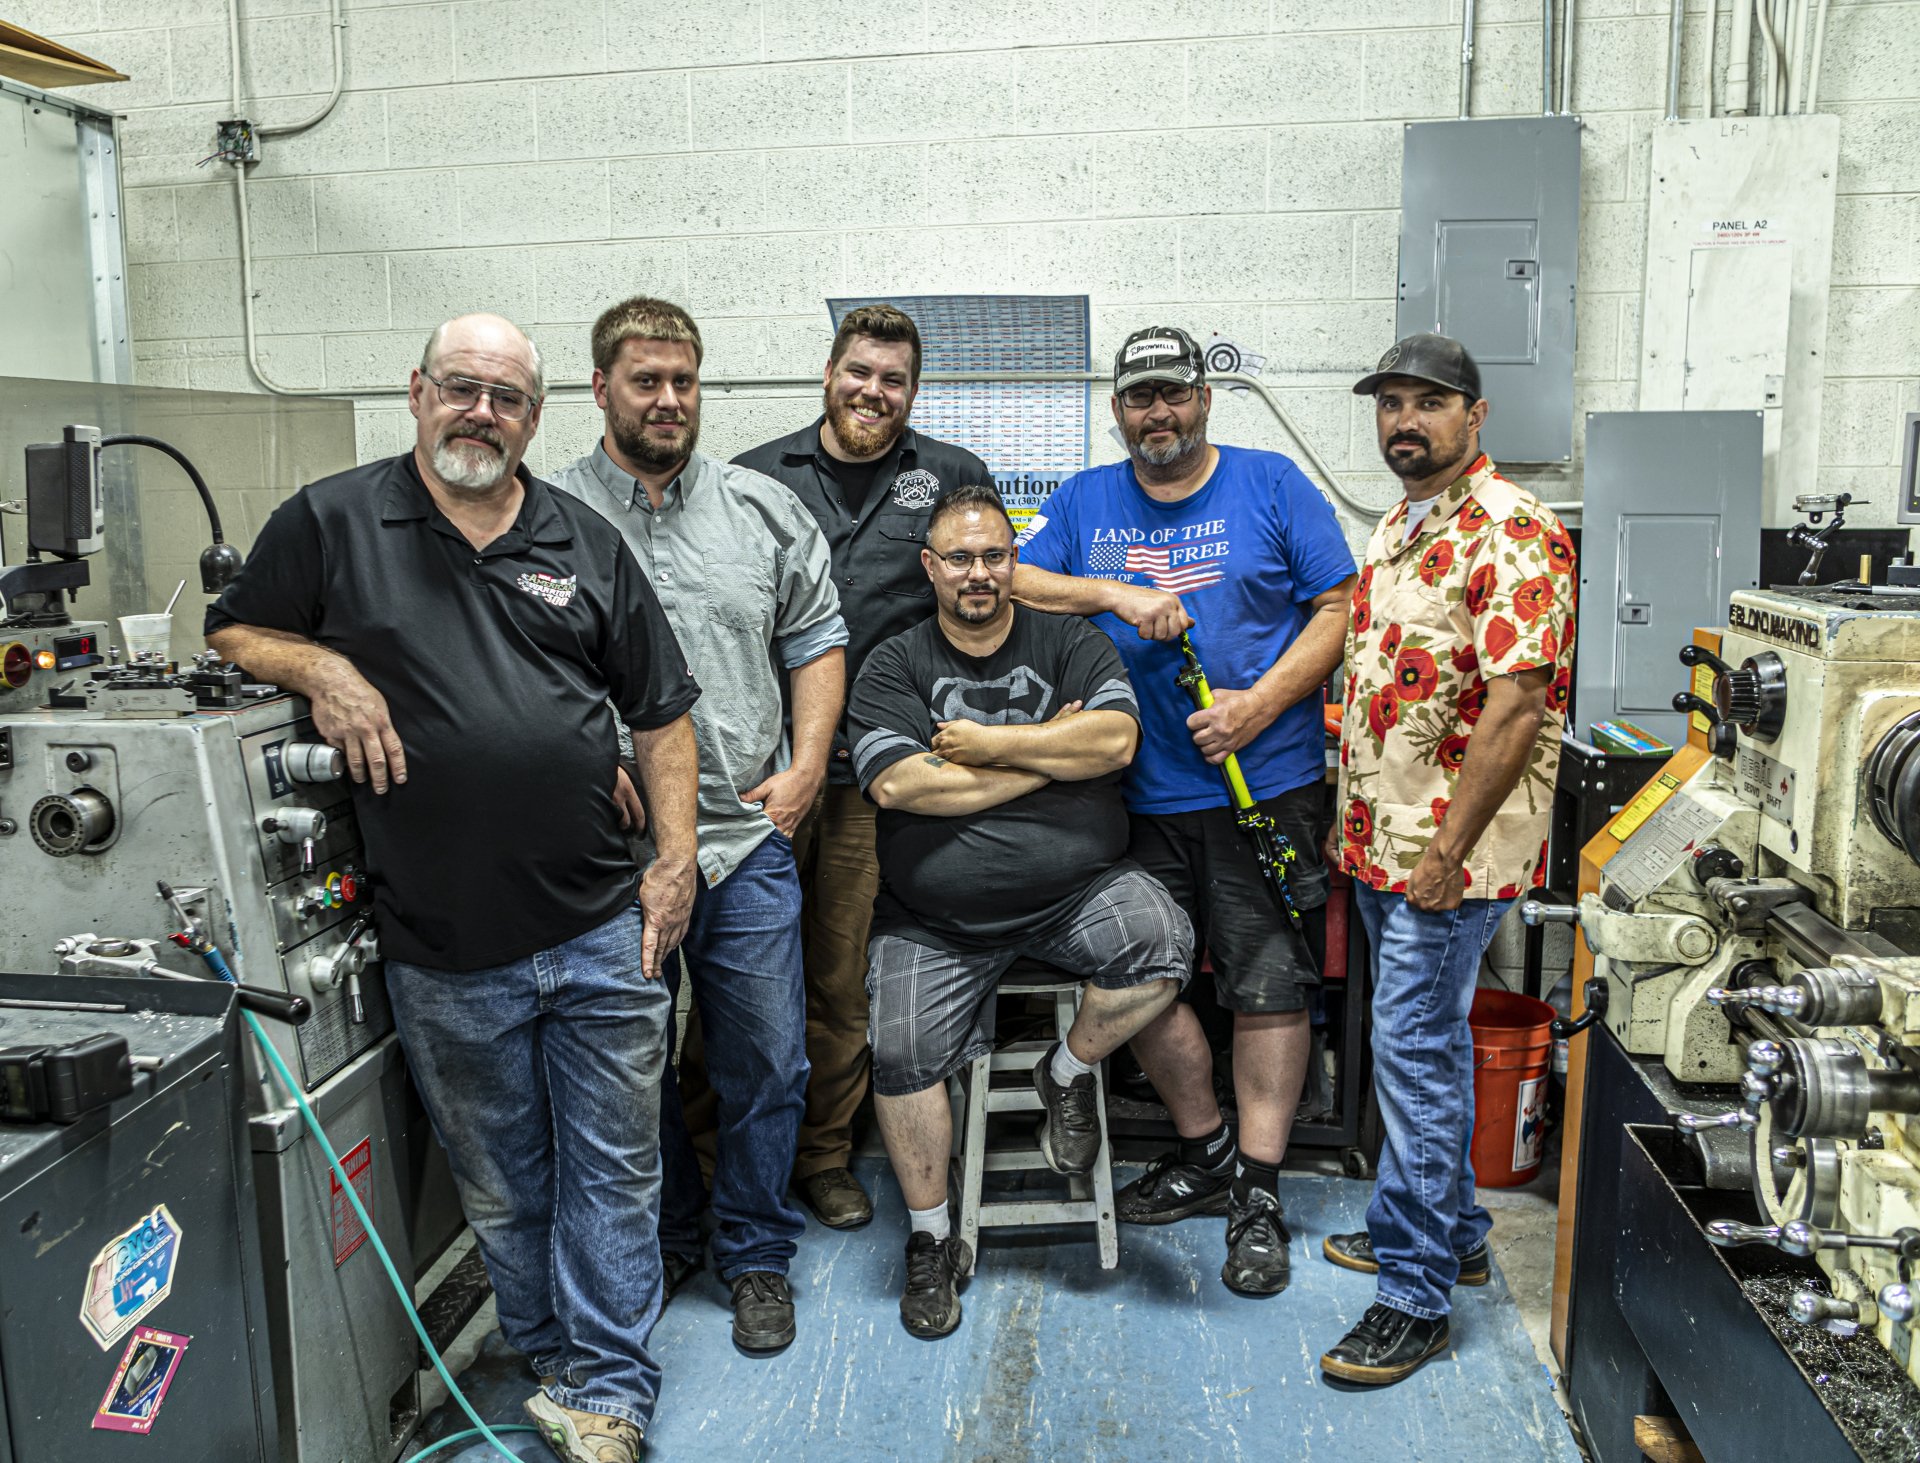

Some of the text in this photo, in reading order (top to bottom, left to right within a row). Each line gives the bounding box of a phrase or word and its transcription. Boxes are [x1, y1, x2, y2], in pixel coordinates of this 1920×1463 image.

[1712, 219, 1768, 231] PANEL A2
[1136, 343, 1175, 354] BROWNELLS
[991, 474, 1059, 495] ution
[1018, 496, 1040, 506] (303)
[1091, 518, 1226, 544] LAND OF THE
[1171, 541, 1230, 566] FREE
[1117, 573, 1135, 583] OF
[1743, 781, 1782, 810] SERVO SHIFT
[1171, 1180, 1194, 1197] N
